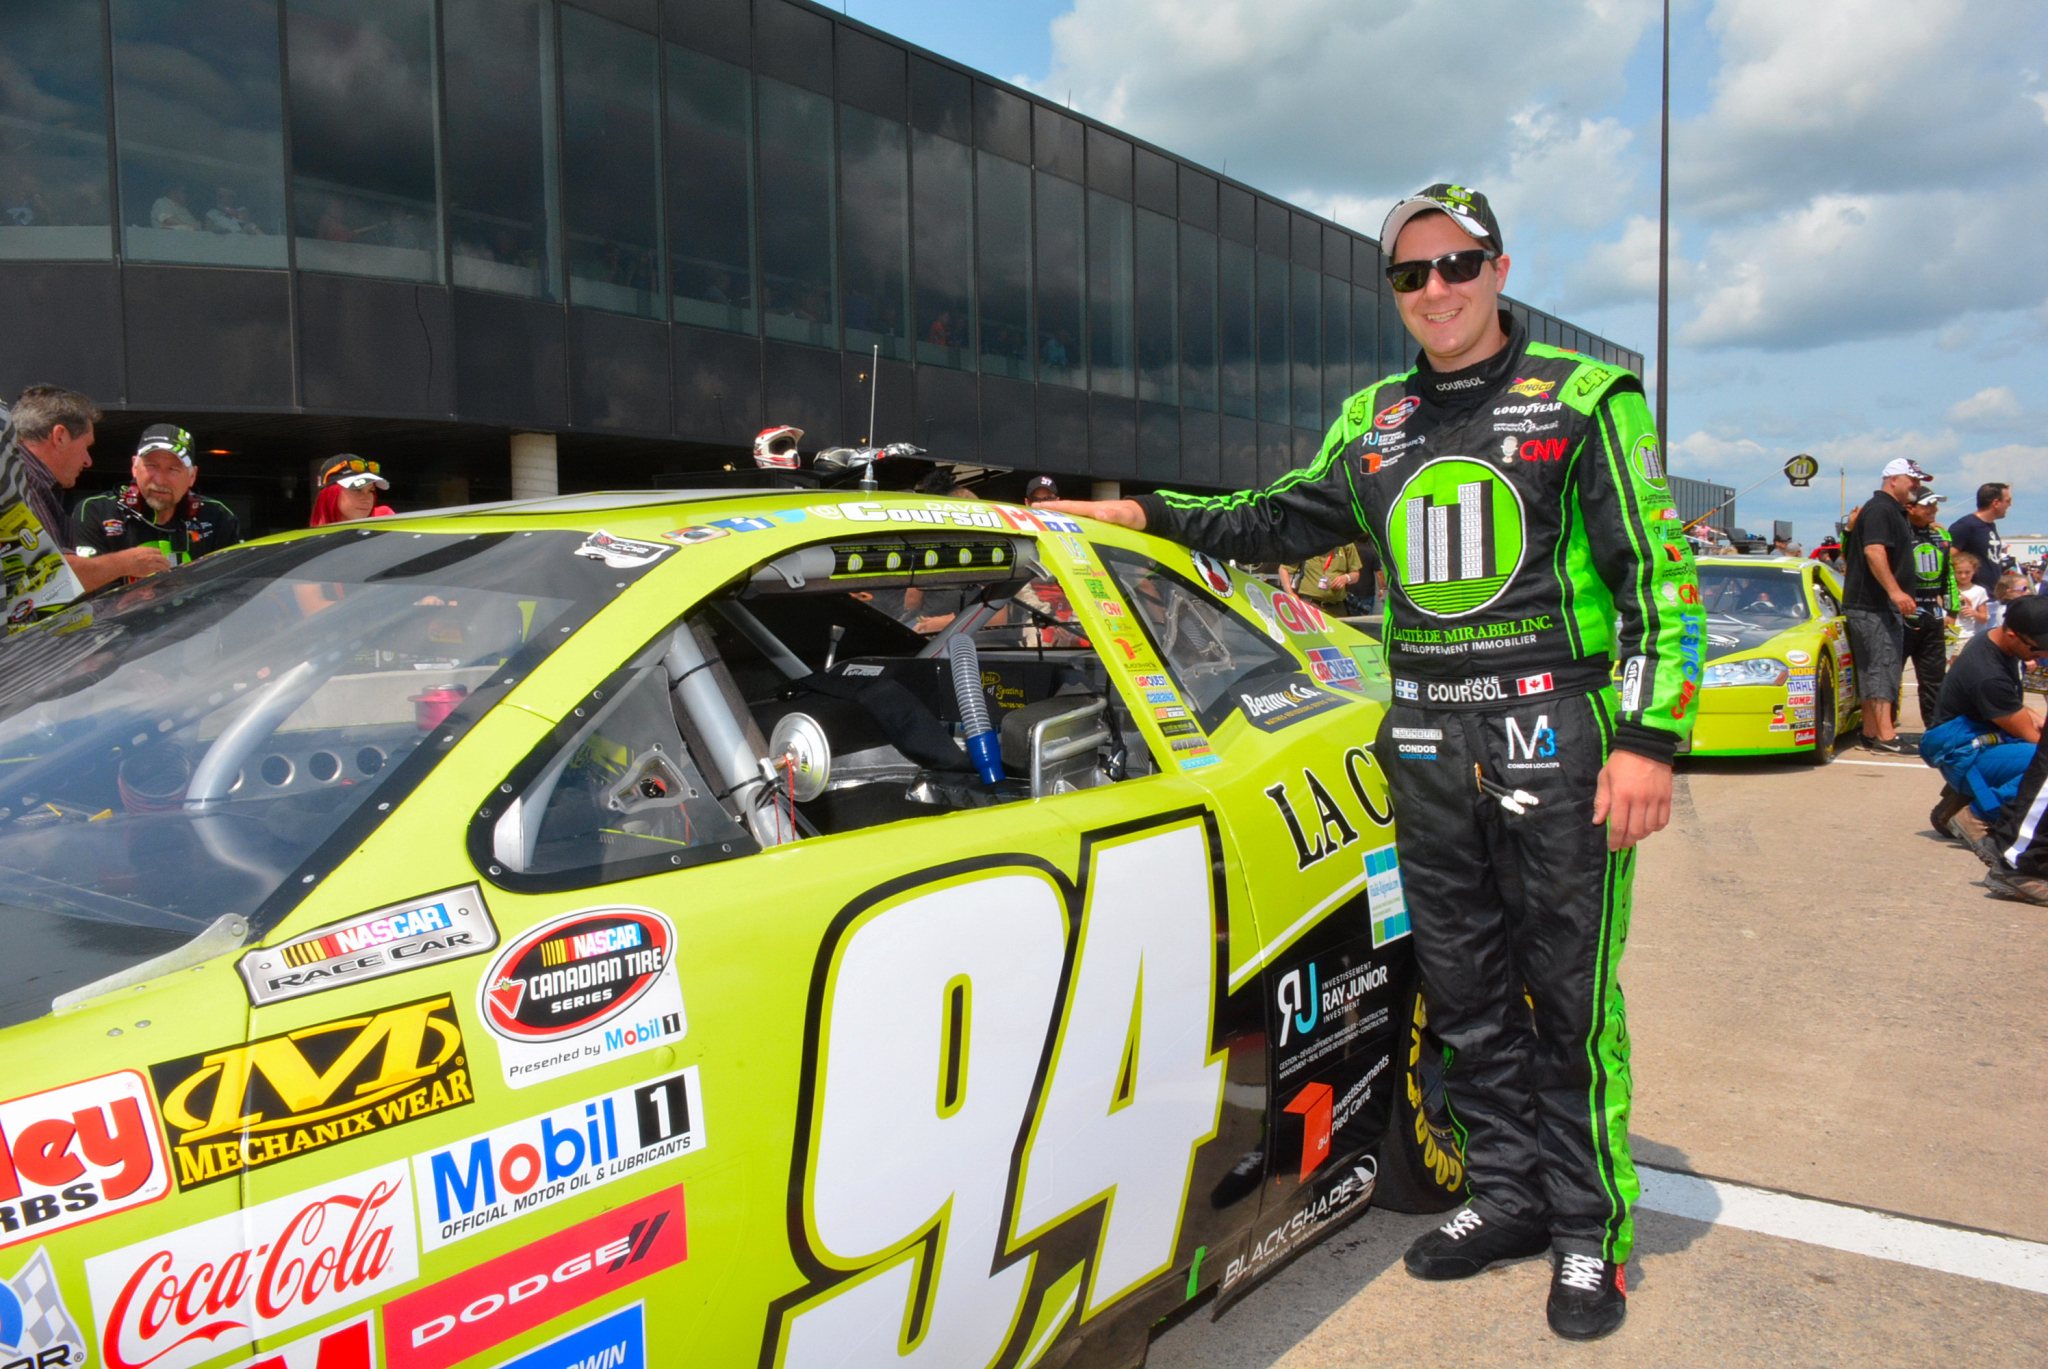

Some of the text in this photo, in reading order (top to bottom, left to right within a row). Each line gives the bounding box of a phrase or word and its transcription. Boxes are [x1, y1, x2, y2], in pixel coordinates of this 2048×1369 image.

[1436, 376, 1485, 391] COURSOL
[1493, 402, 1563, 416] GOODYEAR
[1520, 438, 1569, 461] CNV
[925, 503, 985, 512] DAVE
[1444, 622, 1517, 643] MIRABEL
[1521, 615, 1553, 633] INC.
[1472, 634, 1537, 651] IMMOBILIER
[1428, 683, 1508, 702] COURSOL
[1465, 676, 1500, 686] DAVE
[1399, 744, 1437, 754] CONDOS
[1505, 715, 1557, 760] M3
[1265, 767, 1358, 872] LA
[336, 905, 445, 954] NASCAR
[573, 923, 641, 960] NASCAR
[266, 931, 479, 993] RACE CAR
[529, 946, 664, 1001] CANADIAN TIRE
[1322, 961, 1371, 990] INVESTISSEMENT
[551, 988, 613, 1014] SERIES
[1322, 965, 1388, 1013] RAY JUNIOR
[1323, 999, 1360, 1024] INVESTMENT
[509, 1048, 580, 1078] Presented
[584, 1043, 601, 1056] by
[605, 1018, 661, 1051] Mobil
[1279, 1058, 1307, 1080] MANAGEMENT
[758, 803, 1228, 1369] 94
[1332, 1053, 1389, 1118] Investissements
[174, 1069, 473, 1186] MECHANIX WEAR
[1317, 1086, 1372, 1150] au Pied Carré
[431, 1097, 619, 1224] Mobil
[441, 1136, 691, 1240] OFFICIAL MOTOR OIL & LUBRICANTS
[103, 1174, 405, 1369] Coca-Cola
[411, 1235, 630, 1349] DODGE
